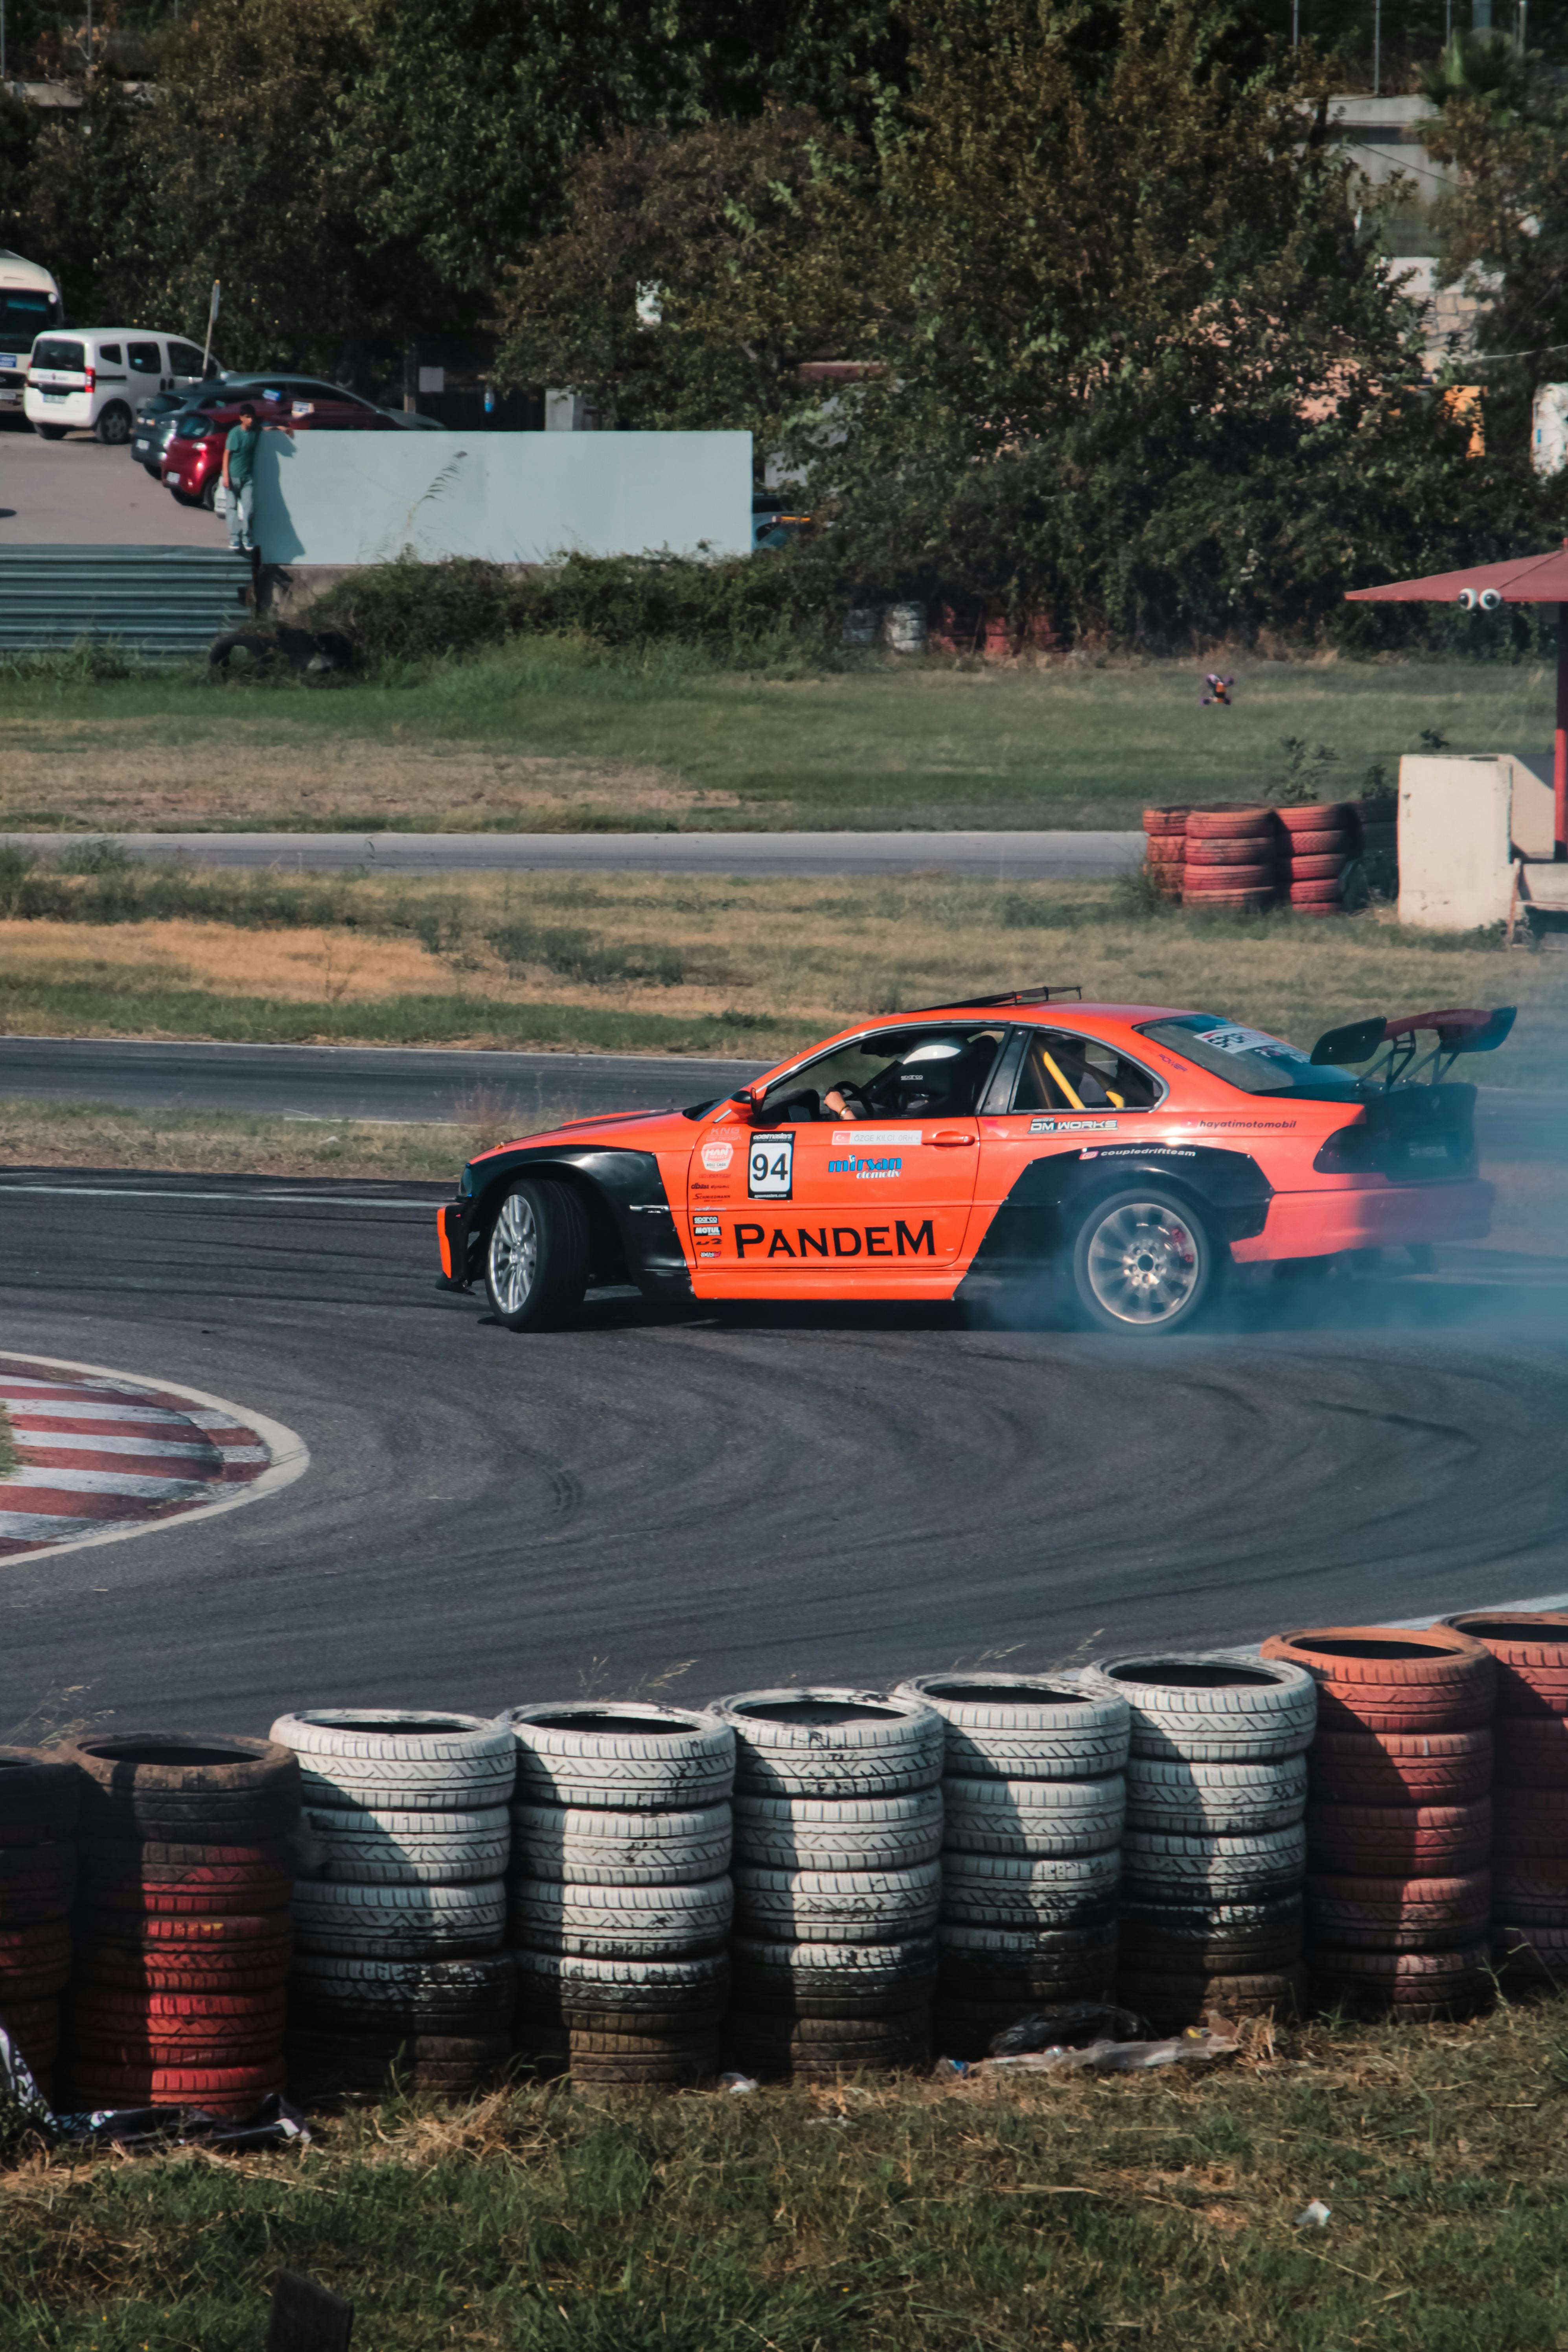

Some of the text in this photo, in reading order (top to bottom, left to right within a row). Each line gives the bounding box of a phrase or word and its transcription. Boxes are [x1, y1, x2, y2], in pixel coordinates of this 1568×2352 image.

[1030, 1119, 1118, 1131] DM WORKS
[1200, 1120, 1297, 1129] hayatimotomobil
[1101, 1148, 1196, 1157] coupledriftteam
[752, 1153, 788, 1181] 94
[828, 1155, 902, 1172] mirsan
[856, 1170, 901, 1179] otomotiv
[733, 1220, 937, 1258] PANDEM
